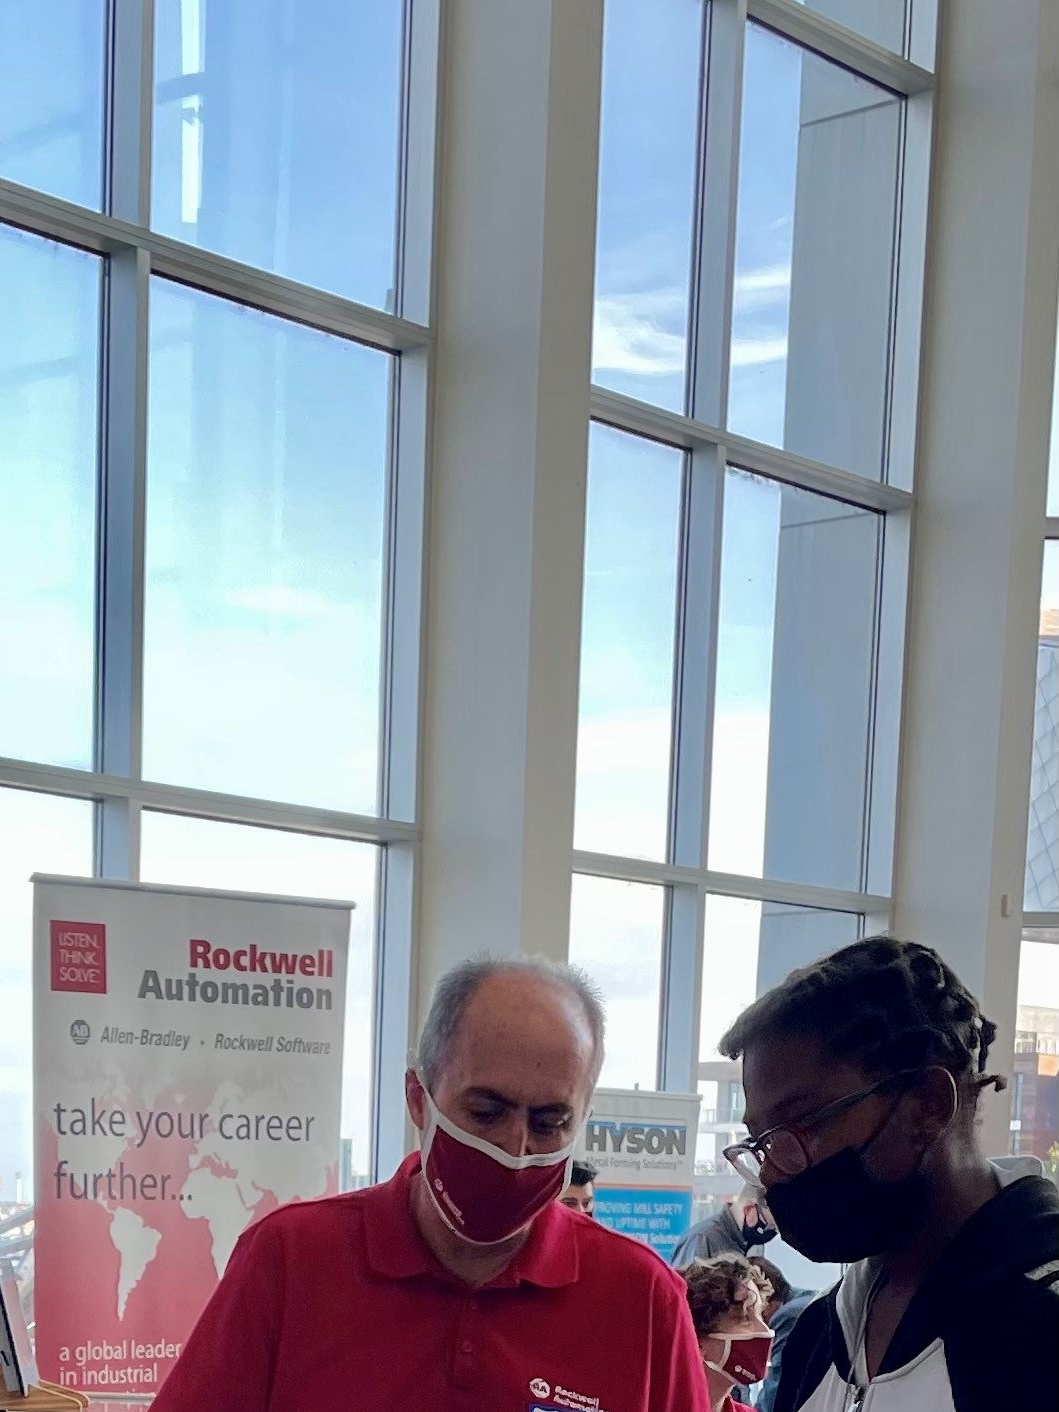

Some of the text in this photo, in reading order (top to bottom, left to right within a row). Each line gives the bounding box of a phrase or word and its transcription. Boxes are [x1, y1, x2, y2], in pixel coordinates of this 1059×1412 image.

[189, 939, 333, 978] Rockwell
[138, 969, 333, 1011] Automation
[100, 1026, 191, 1051] Allen-Bradley
[214, 1033, 331, 1055] Rockwell Software
[53, 1098, 315, 1147] take your career
[586, 1125, 687, 1156] HYSON
[53, 1160, 193, 1202] further...
[653, 1203, 683, 1215] SAFETY
[59, 1338, 182, 1366] a global leader
[60, 1363, 158, 1386] in industrial
